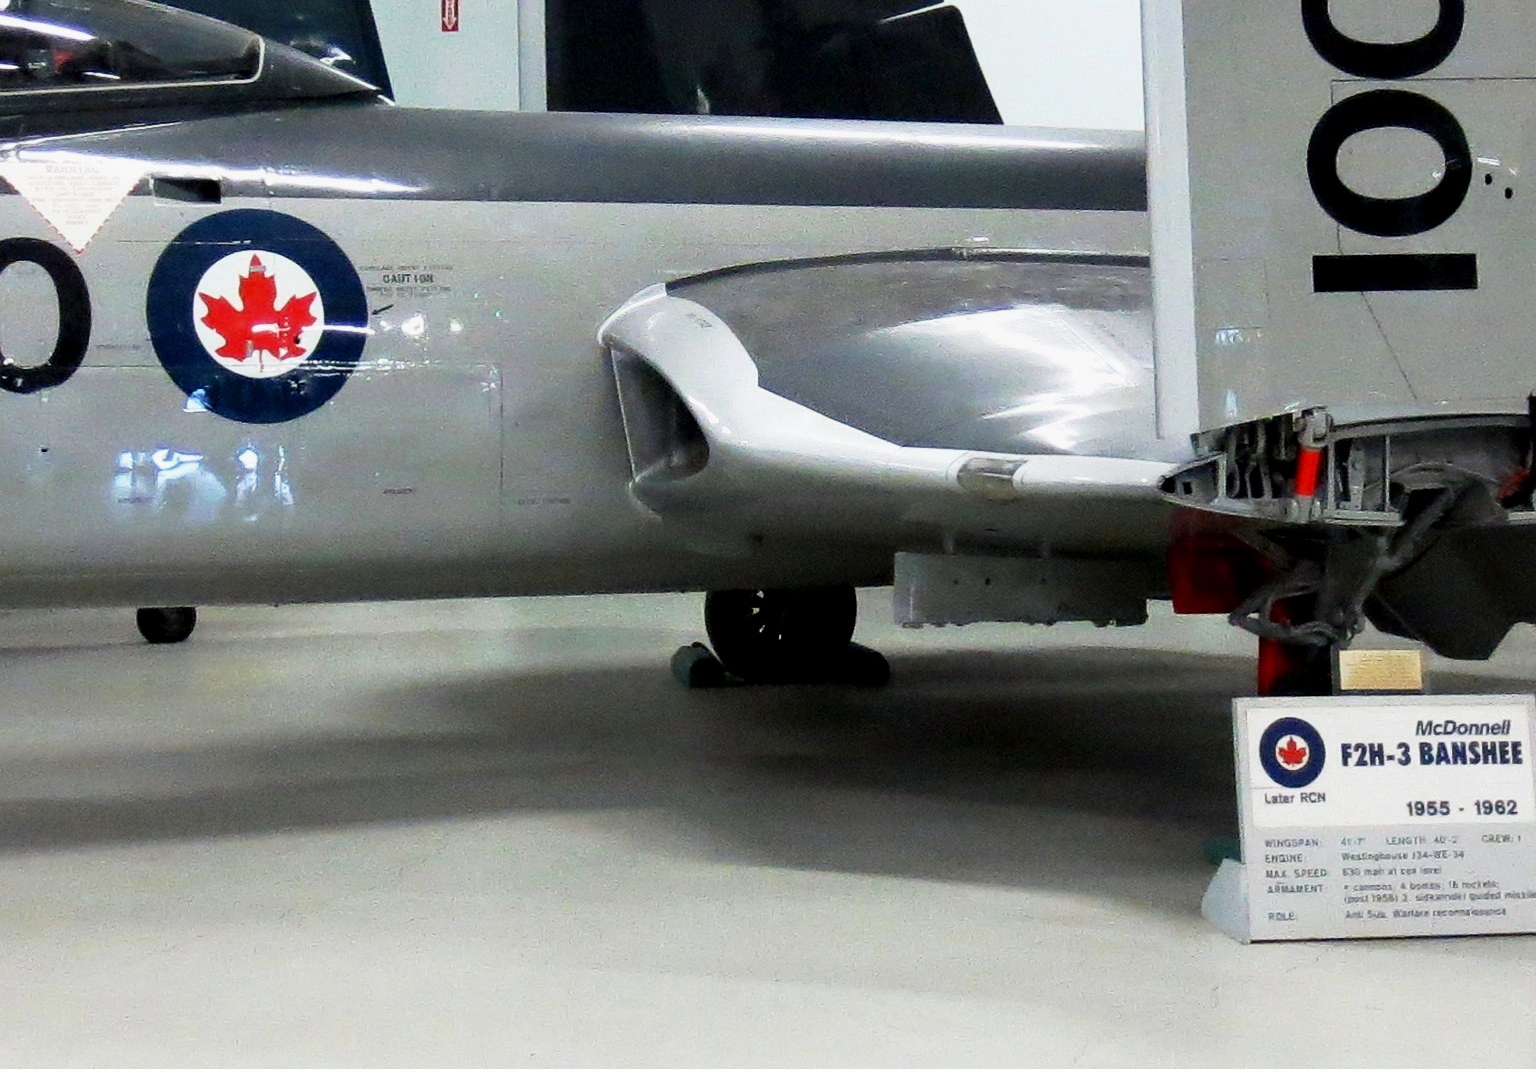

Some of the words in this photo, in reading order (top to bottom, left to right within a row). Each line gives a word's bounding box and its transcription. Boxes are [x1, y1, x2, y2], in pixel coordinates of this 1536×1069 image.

[1415, 719, 1512, 737] McDonnell
[1340, 742, 1412, 767] F2H-3
[1419, 740, 1524, 766] BANSHEE
[1264, 792, 1296, 805] Later
[1300, 791, 1326, 804] RCN
[1406, 800, 1451, 818] 1955
[1474, 799, 1519, 817] 1962
